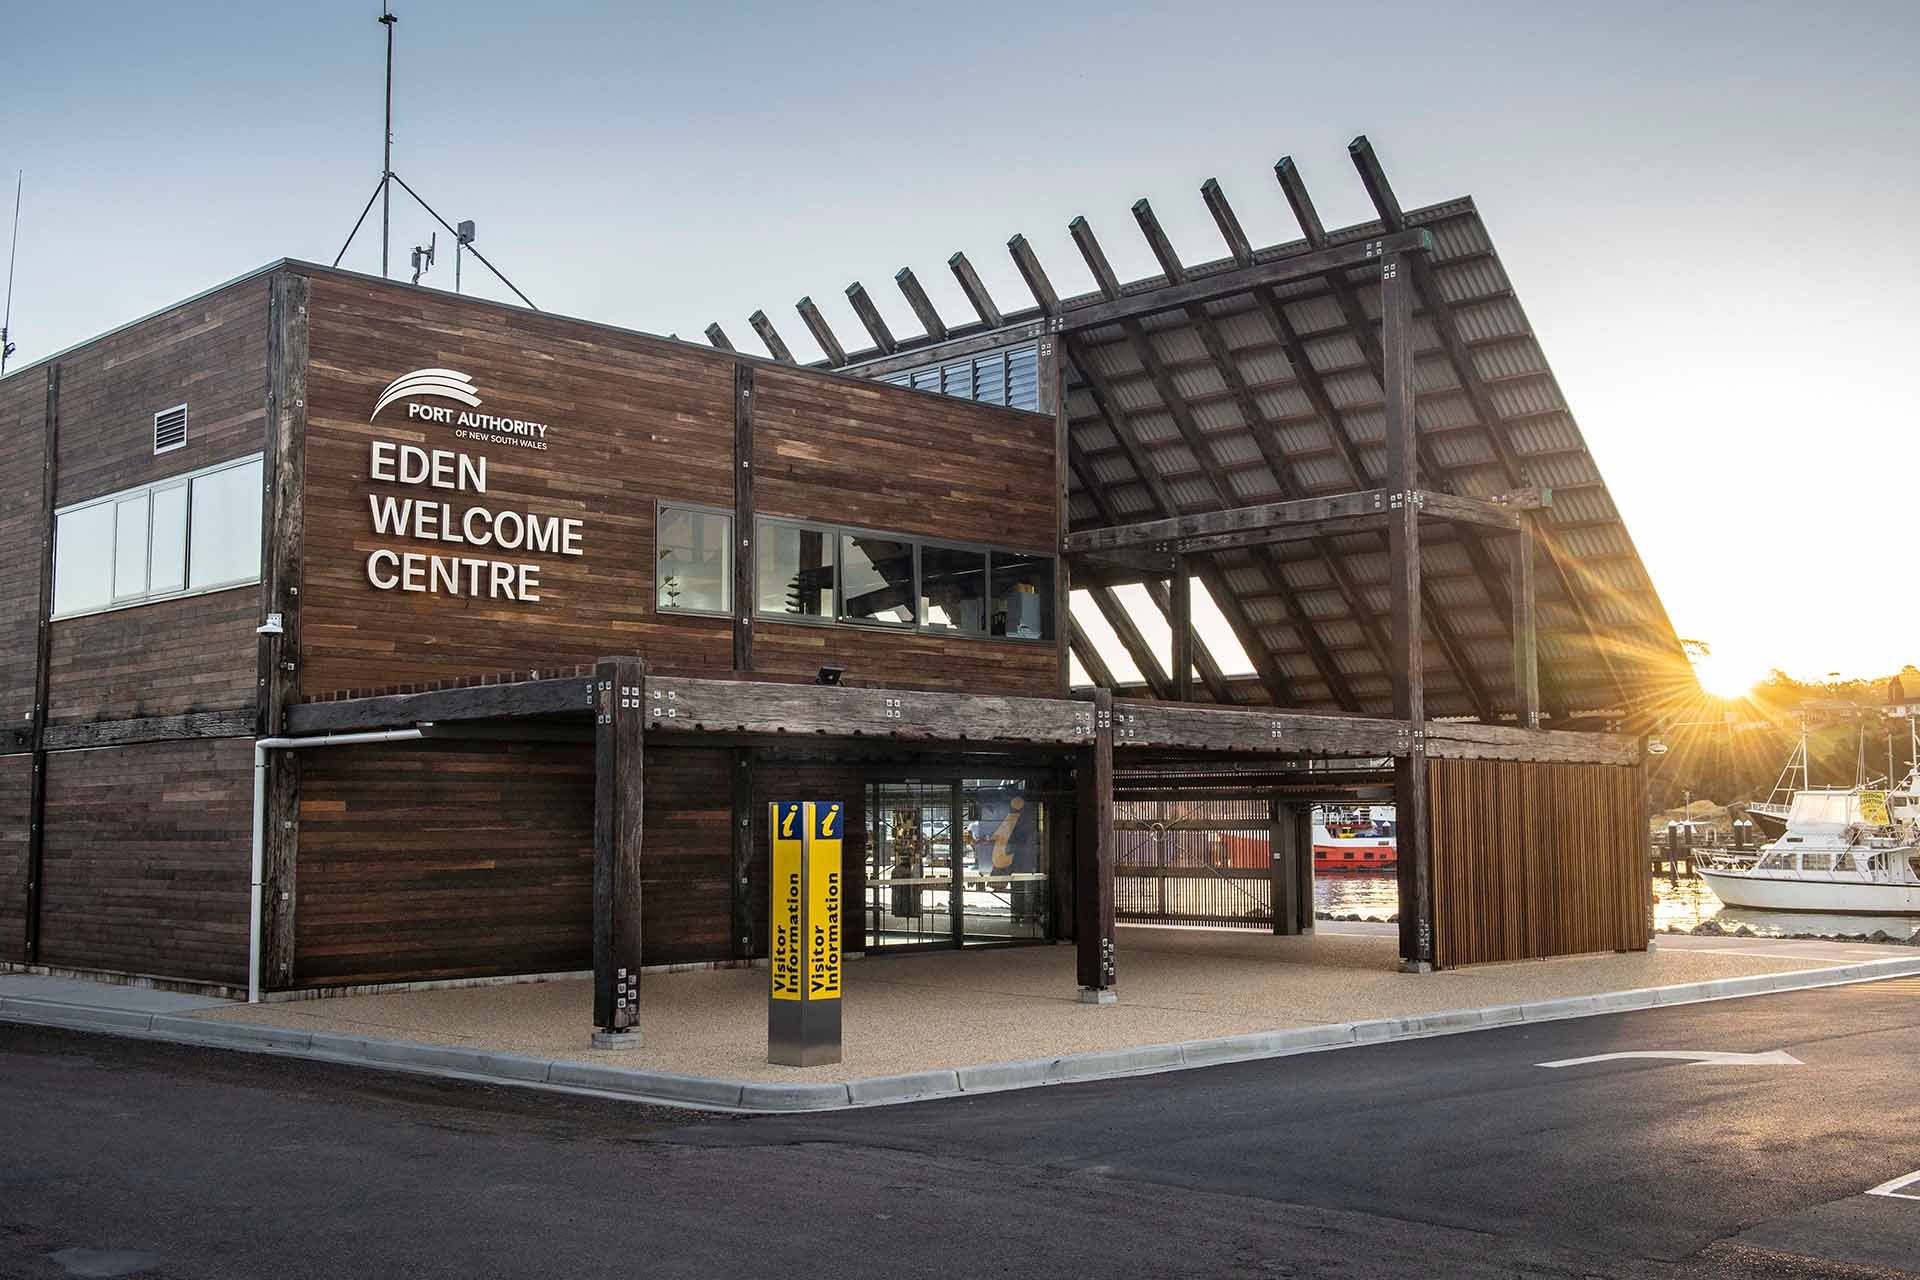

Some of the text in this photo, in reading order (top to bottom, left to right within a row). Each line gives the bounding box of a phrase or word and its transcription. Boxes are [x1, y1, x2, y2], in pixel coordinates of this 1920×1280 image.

[408, 402, 548, 438] PORT AUTHORITY
[455, 429, 548, 450] OF NEW SOUTH WALES
[371, 440, 487, 493] EDEN
[369, 494, 584, 556] WELCOME
[367, 549, 541, 602] CENTRE
[774, 925, 786, 992] Visitor
[786, 873, 799, 993] Information
[811, 925, 825, 993] Visitor
[825, 872, 839, 992] Information
